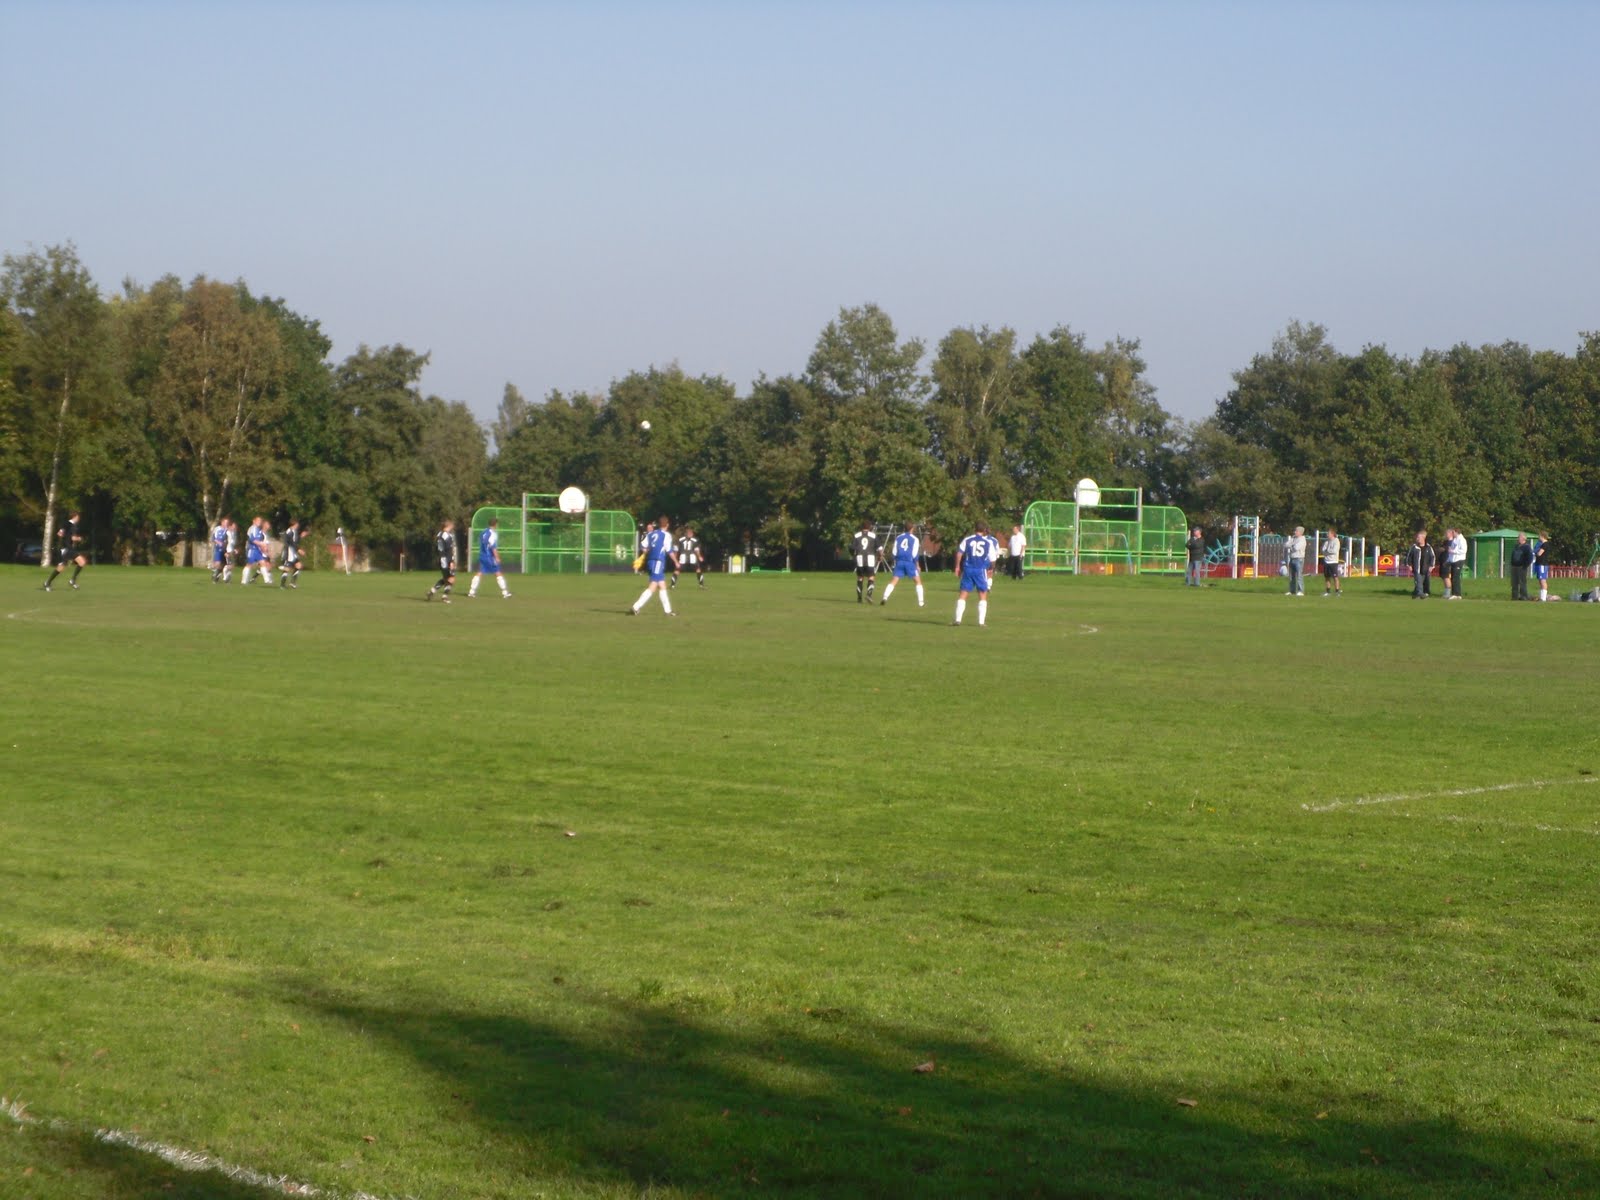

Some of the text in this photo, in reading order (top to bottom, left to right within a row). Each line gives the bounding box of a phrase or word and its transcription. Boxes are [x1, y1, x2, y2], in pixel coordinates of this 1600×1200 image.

[683, 541, 692, 551] 11
[861, 537, 869, 550] 9
[900, 538, 909, 551] 4
[969, 540, 985, 557] 15
